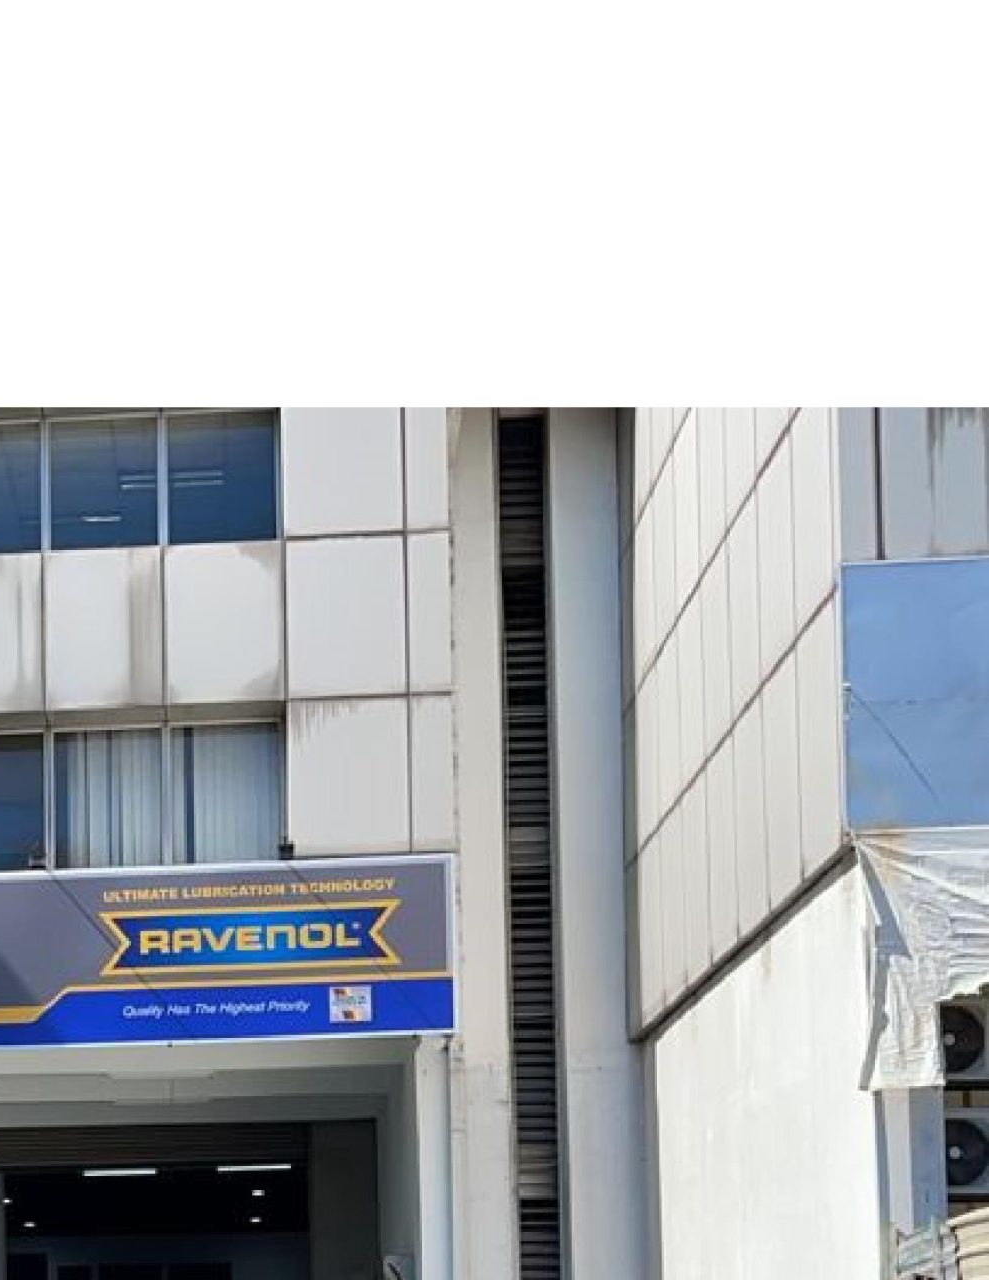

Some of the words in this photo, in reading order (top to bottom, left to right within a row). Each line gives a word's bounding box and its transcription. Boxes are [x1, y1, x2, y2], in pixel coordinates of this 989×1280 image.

[103, 888, 177, 903] ULTIMATE
[183, 884, 284, 899] LUBRICATION
[290, 877, 395, 894] TECHNOLOGY
[139, 923, 361, 955] RAVENOL
[122, 1005, 164, 1019] Quality
[167, 1004, 190, 1016] Has
[195, 1003, 217, 1014] The
[219, 1001, 265, 1016] Highest
[267, 1000, 311, 1014] Priority
